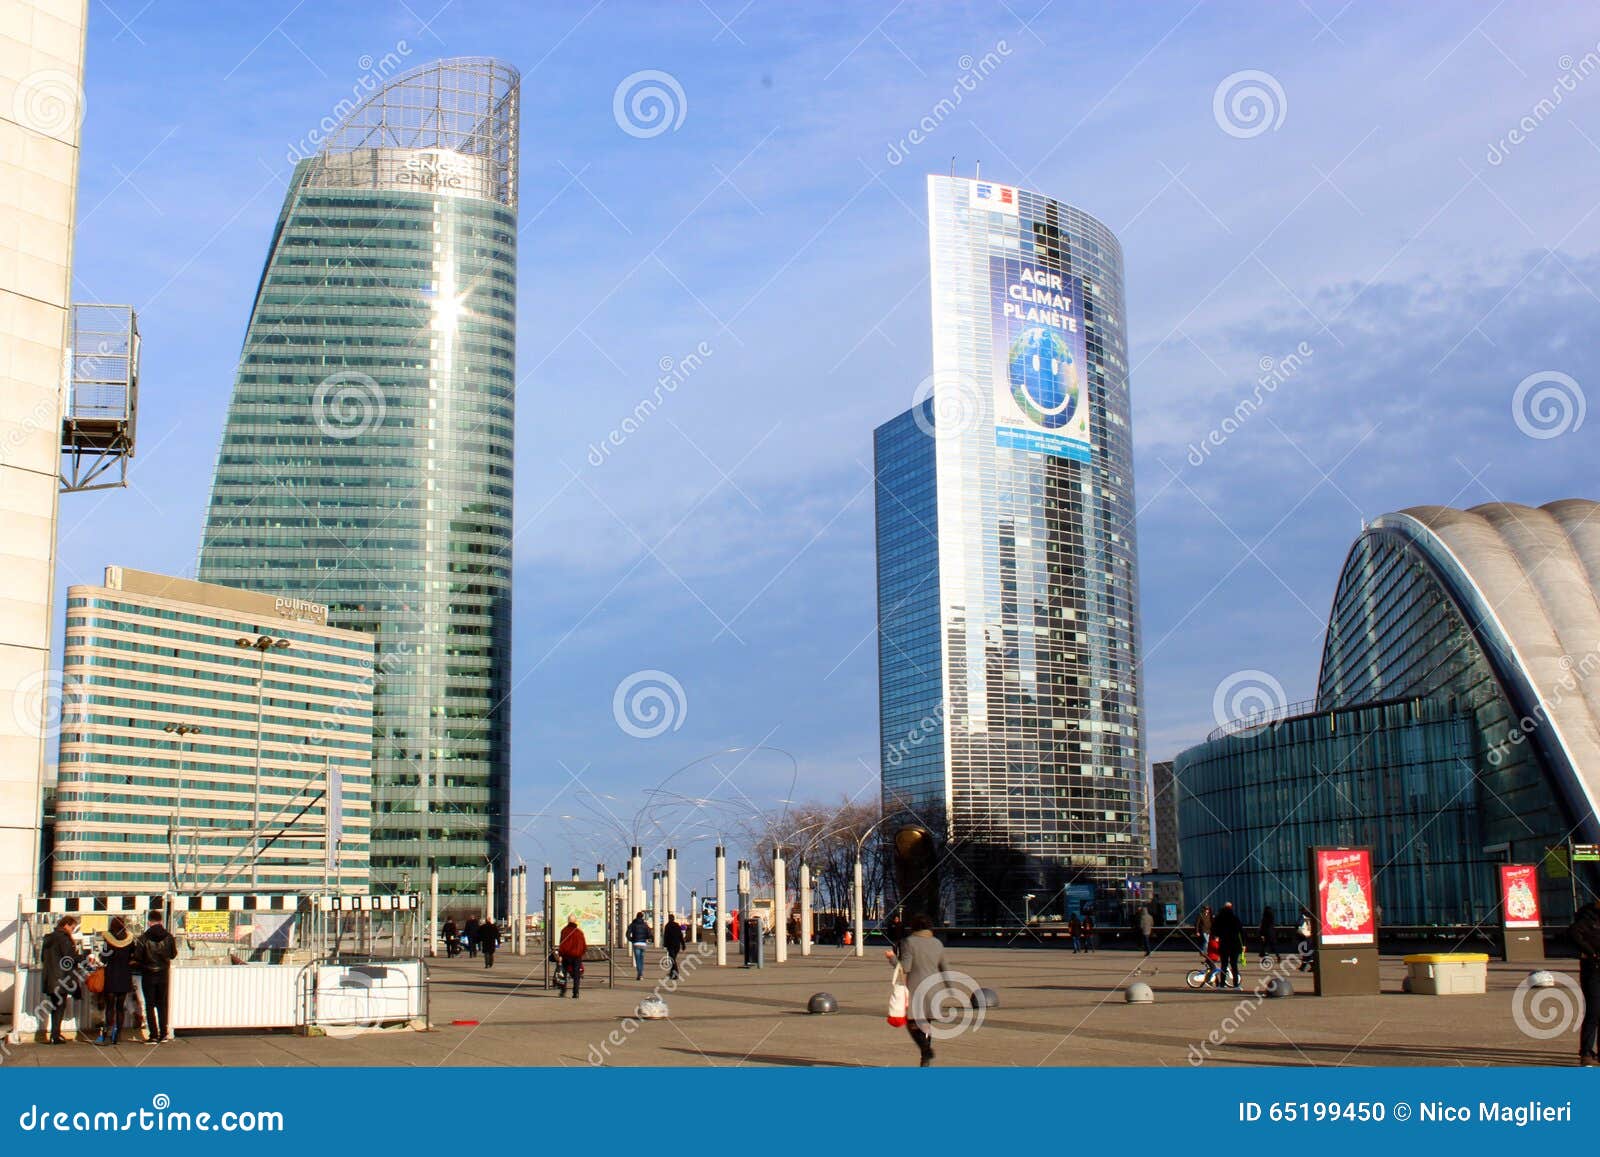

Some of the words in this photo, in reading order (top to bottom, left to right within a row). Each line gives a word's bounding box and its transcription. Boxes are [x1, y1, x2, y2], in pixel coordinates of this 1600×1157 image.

[1021, 268, 1063, 291] AGIR
[1009, 284, 1072, 312] CLIMAT
[1003, 302, 1078, 333] PLANÈTE
[275, 597, 328, 614] pullman
